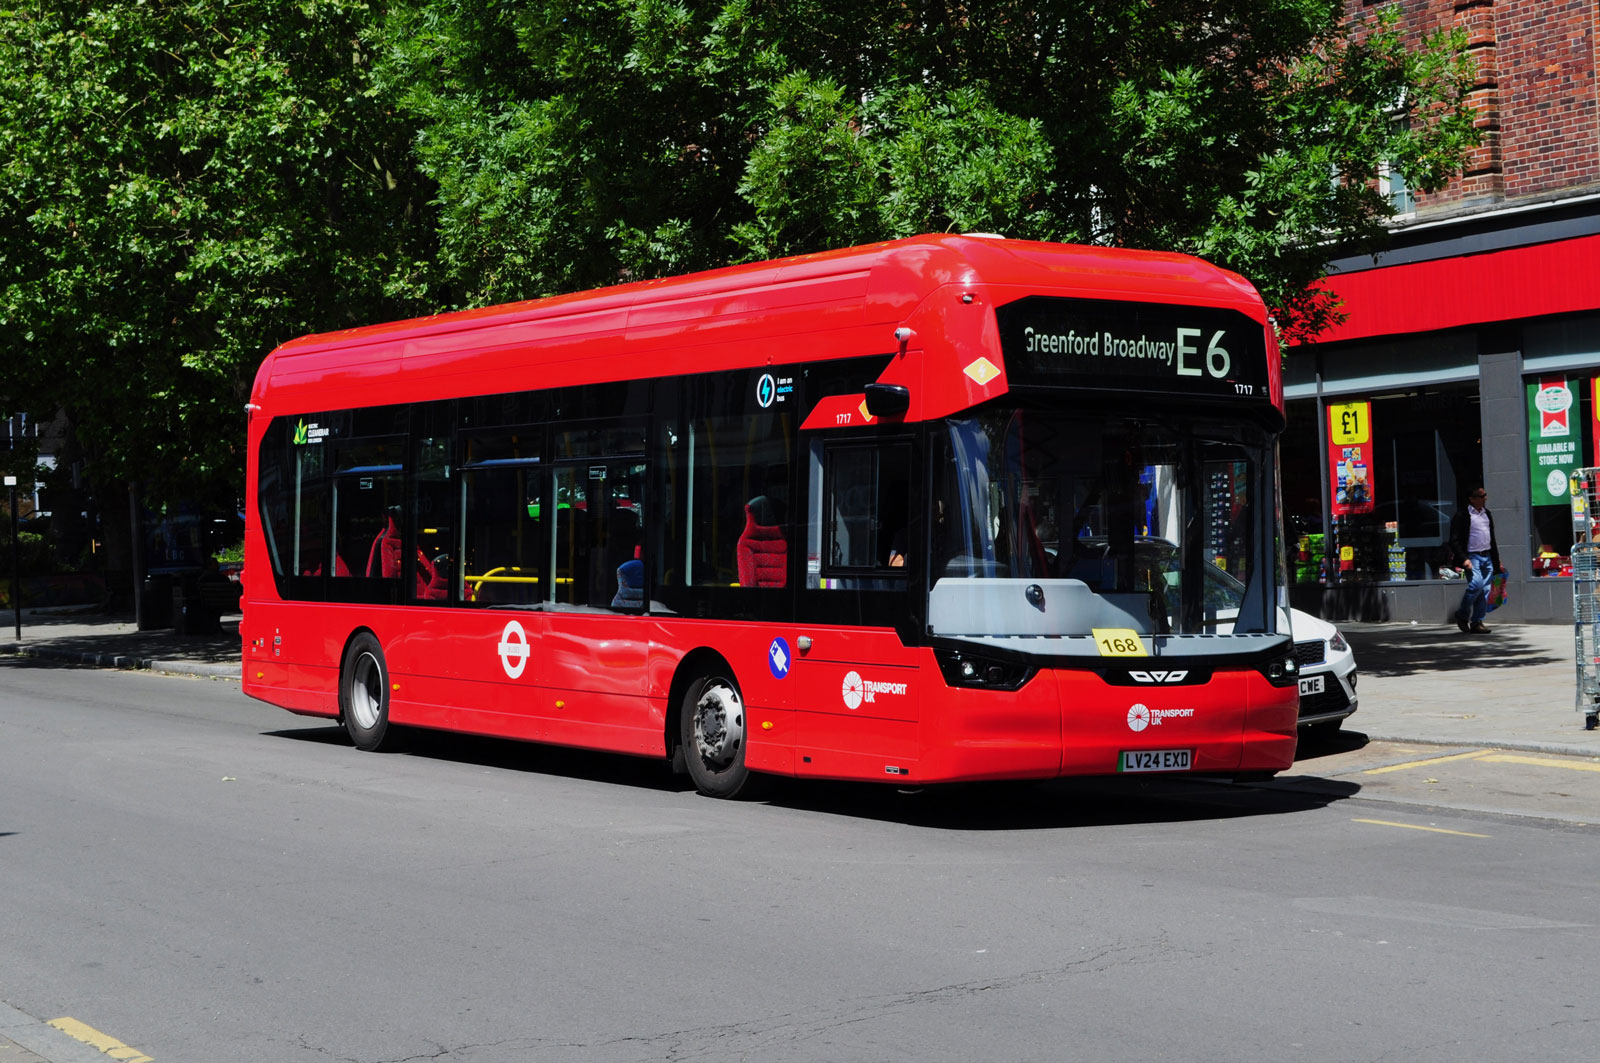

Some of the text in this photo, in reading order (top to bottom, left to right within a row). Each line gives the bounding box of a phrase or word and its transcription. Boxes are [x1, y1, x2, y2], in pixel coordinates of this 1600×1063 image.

[1024, 326, 1175, 366] Greenford Broadway
[1176, 327, 1231, 379] E6
[1234, 384, 1253, 395] 1717
[836, 413, 851, 425] 1717
[1342, 410, 1358, 435] £1
[1536, 441, 1576, 454] AVAILABLE IN
[1538, 453, 1574, 466] STORE NOW
[1102, 638, 1138, 653] 168
[863, 680, 907, 695] TRANSPORT
[1300, 679, 1320, 694] CWE
[864, 691, 875, 703] UK
[1150, 708, 1195, 718] TRANSPORT
[1151, 717, 1162, 726] UK
[1125, 752, 1188, 769] LV24 EXD
